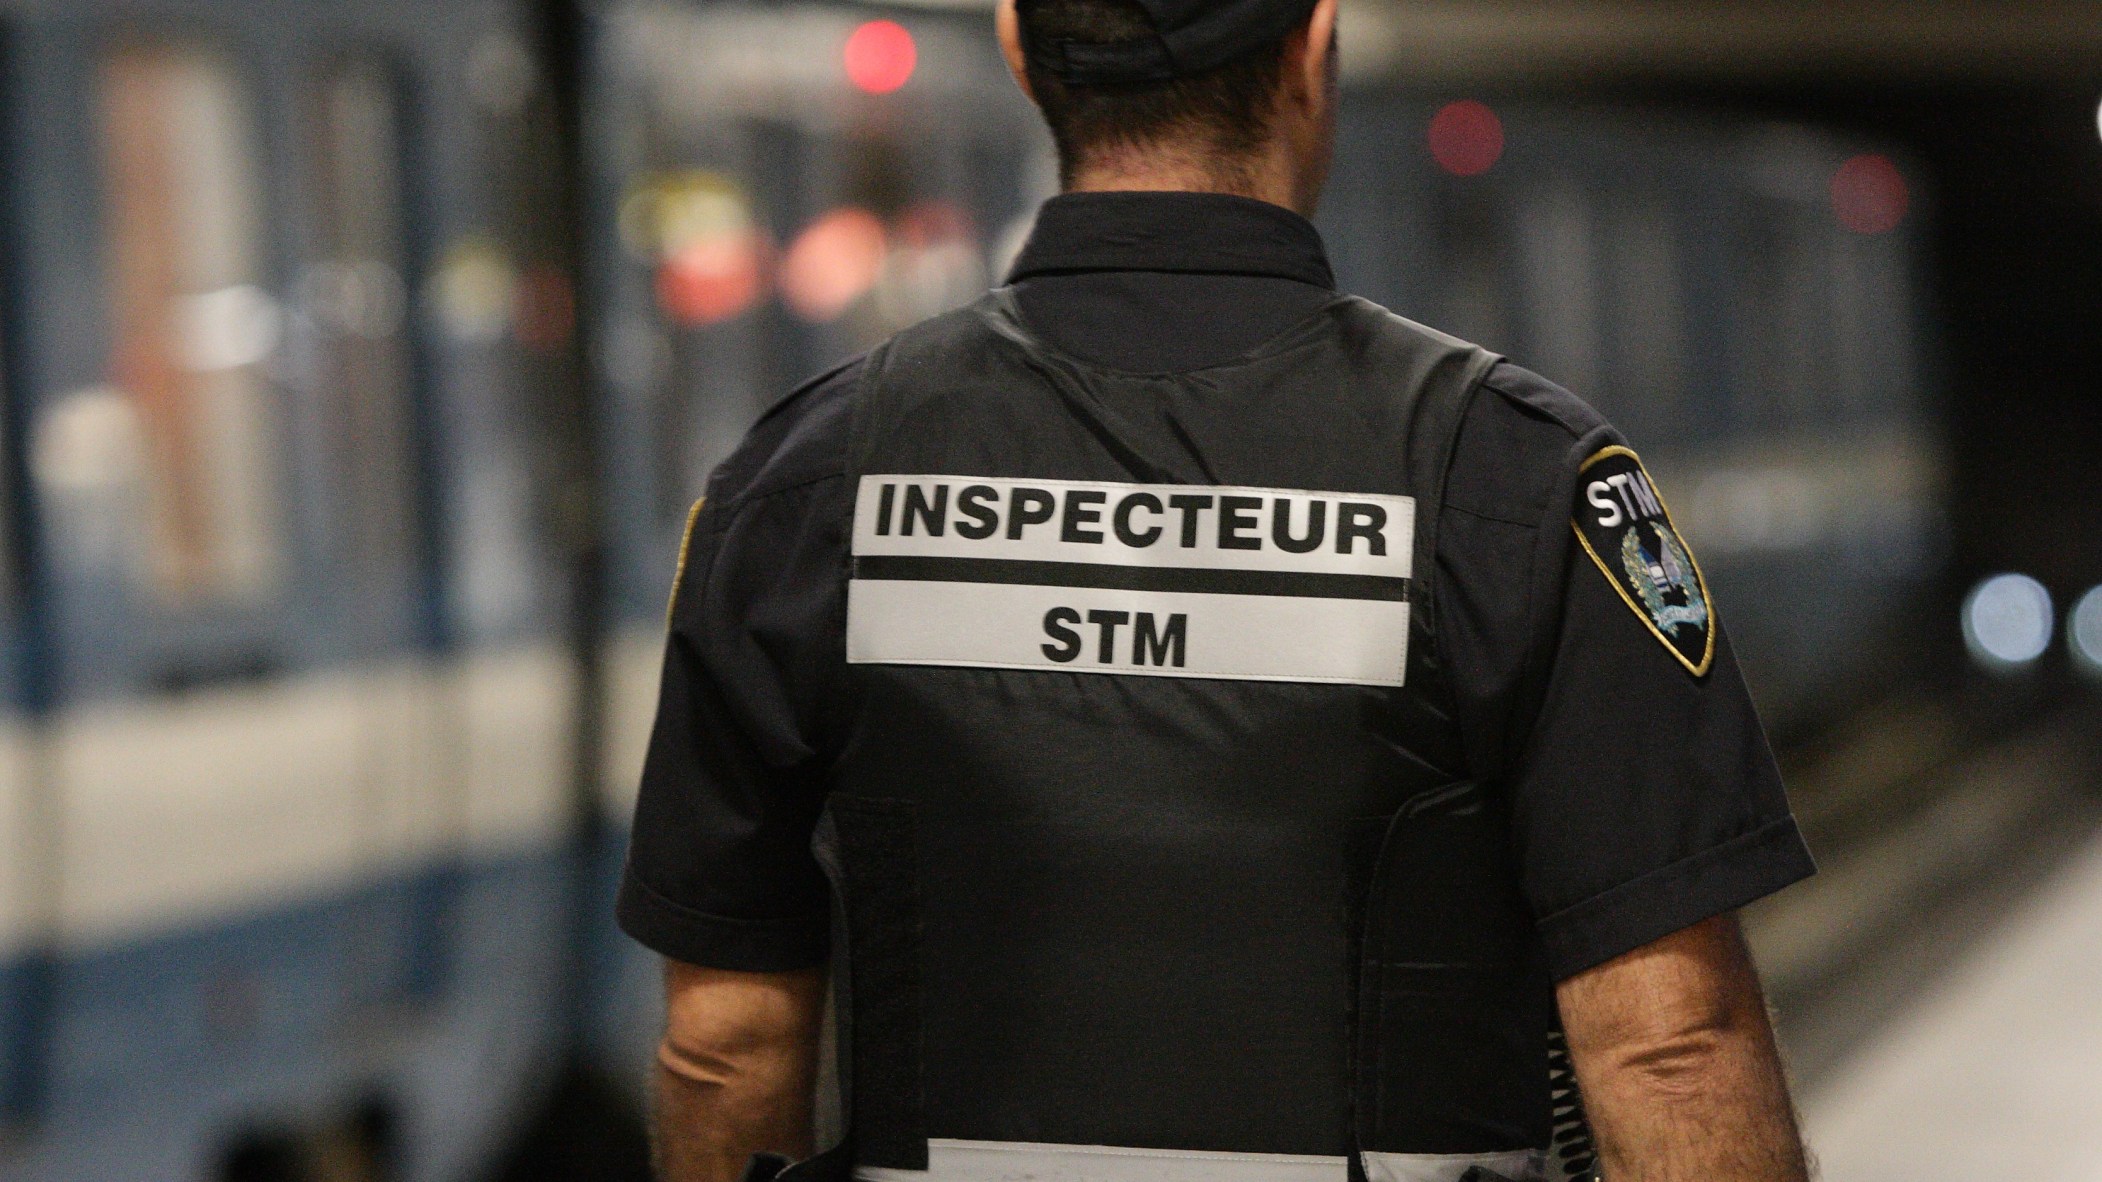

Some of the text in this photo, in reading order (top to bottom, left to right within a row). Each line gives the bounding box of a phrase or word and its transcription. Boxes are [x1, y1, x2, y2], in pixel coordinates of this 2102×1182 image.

[875, 484, 1389, 556] INSPECTEUR
[1587, 470, 1662, 527] STM
[1040, 606, 1188, 667] STM
